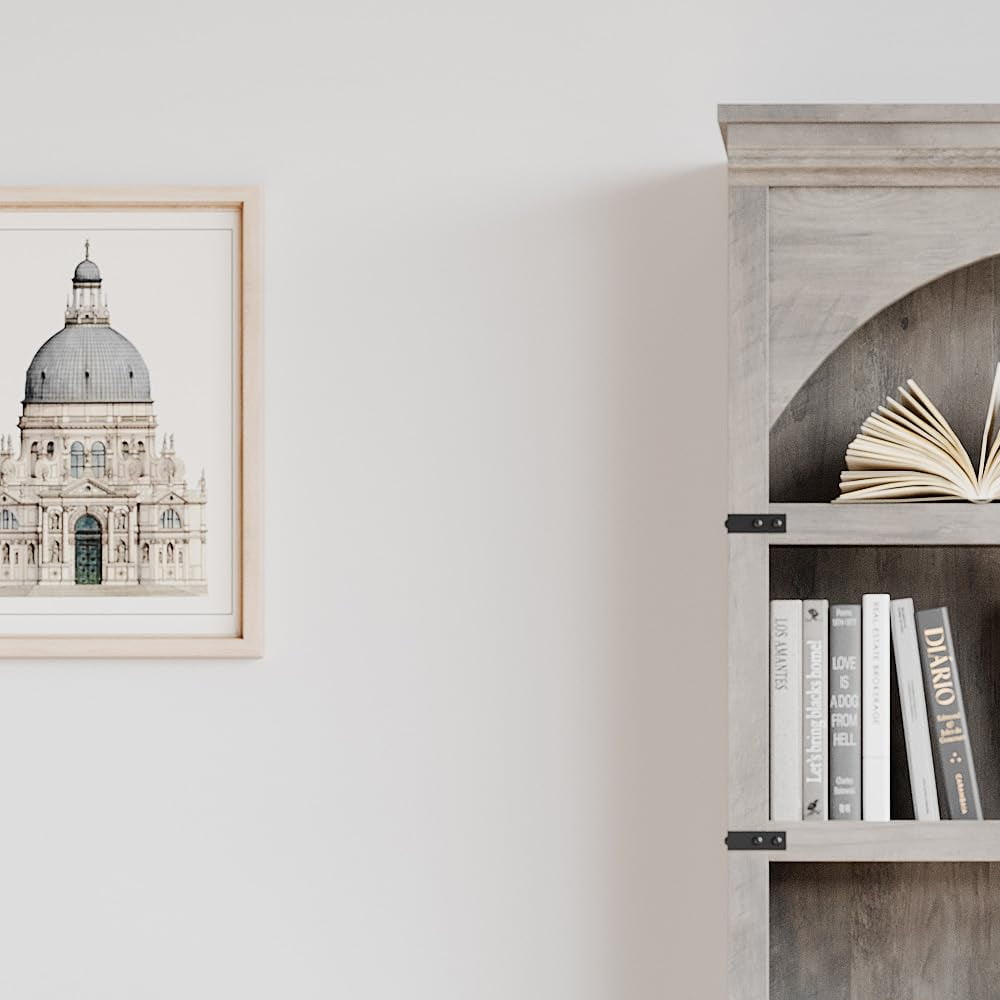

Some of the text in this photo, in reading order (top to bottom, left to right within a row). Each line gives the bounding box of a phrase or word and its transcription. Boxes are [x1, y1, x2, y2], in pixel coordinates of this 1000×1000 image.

[775, 618, 788, 690] LOS AMANTES
[806, 640, 822, 678] home!
[832, 656, 857, 671] LOVE
[923, 627, 956, 706] DIÁRIO
[839, 675, 849, 689] IS
[806, 681, 822, 718] blacks
[806, 720, 826, 753] bring
[831, 713, 858, 728] FROM
[833, 732, 857, 746] HELL
